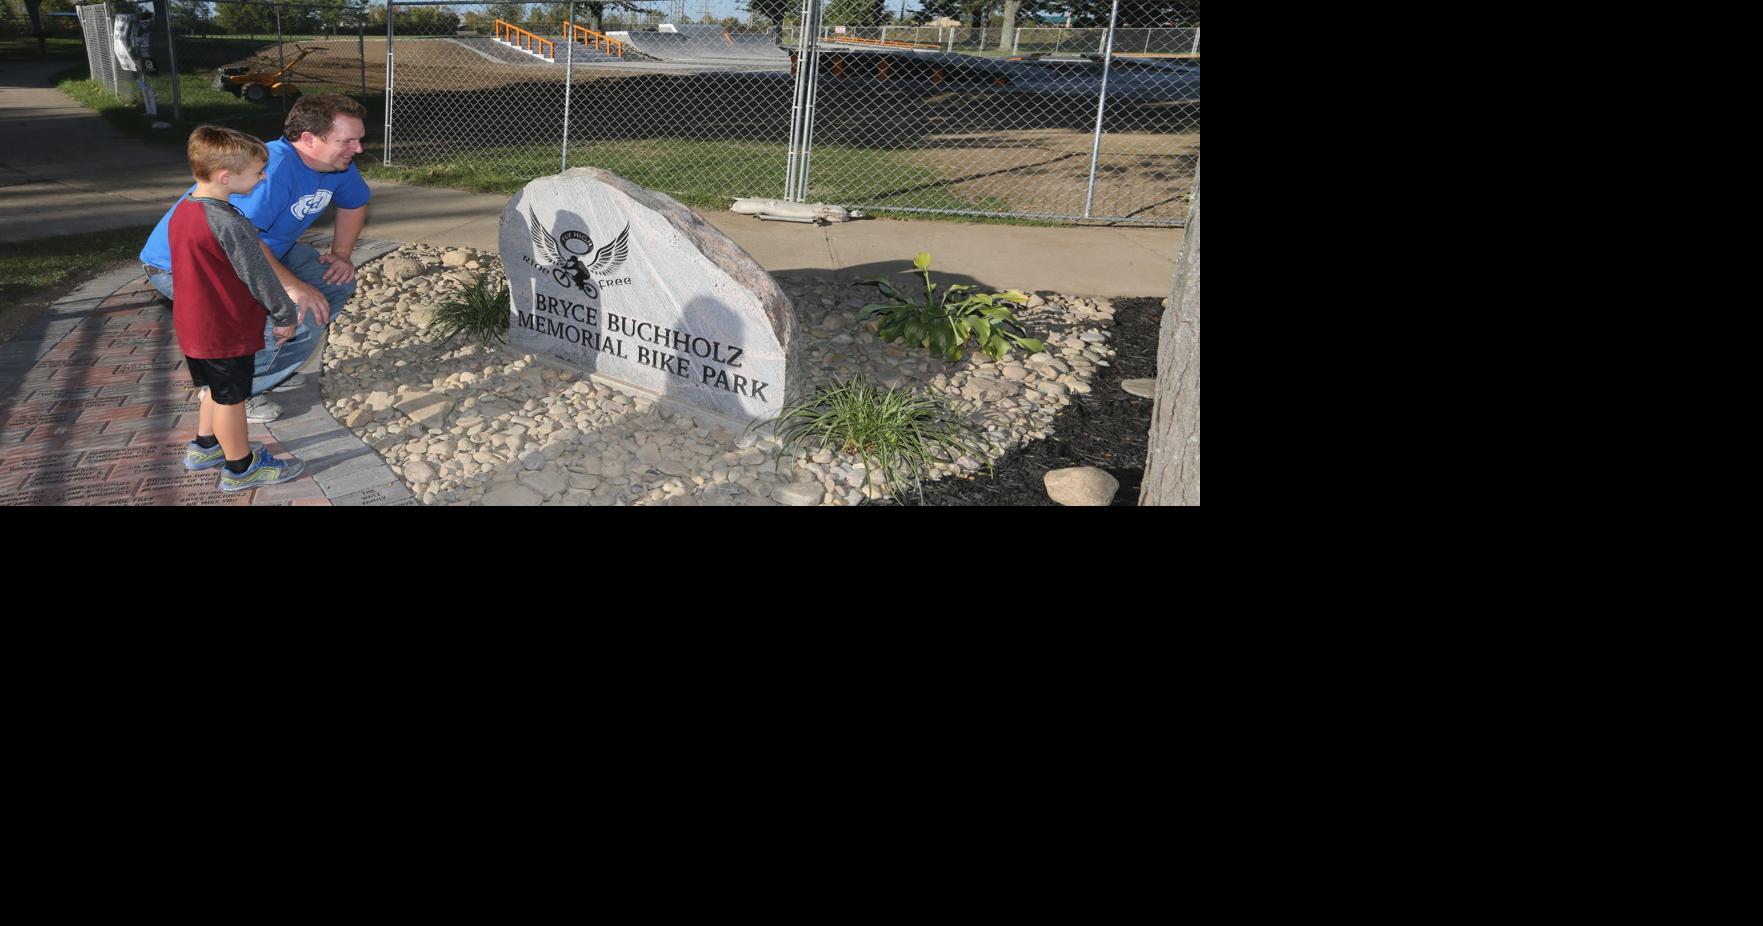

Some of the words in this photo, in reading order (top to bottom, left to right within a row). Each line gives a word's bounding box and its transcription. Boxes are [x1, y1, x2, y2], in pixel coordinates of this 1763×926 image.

[562, 231, 573, 242] FLY
[517, 309, 628, 359] MEMORIAL
[637, 345, 690, 379] BIKE
[701, 364, 769, 403] PARK
[535, 292, 598, 326] BRYCE
[607, 312, 744, 368] BUCHHOLZ
